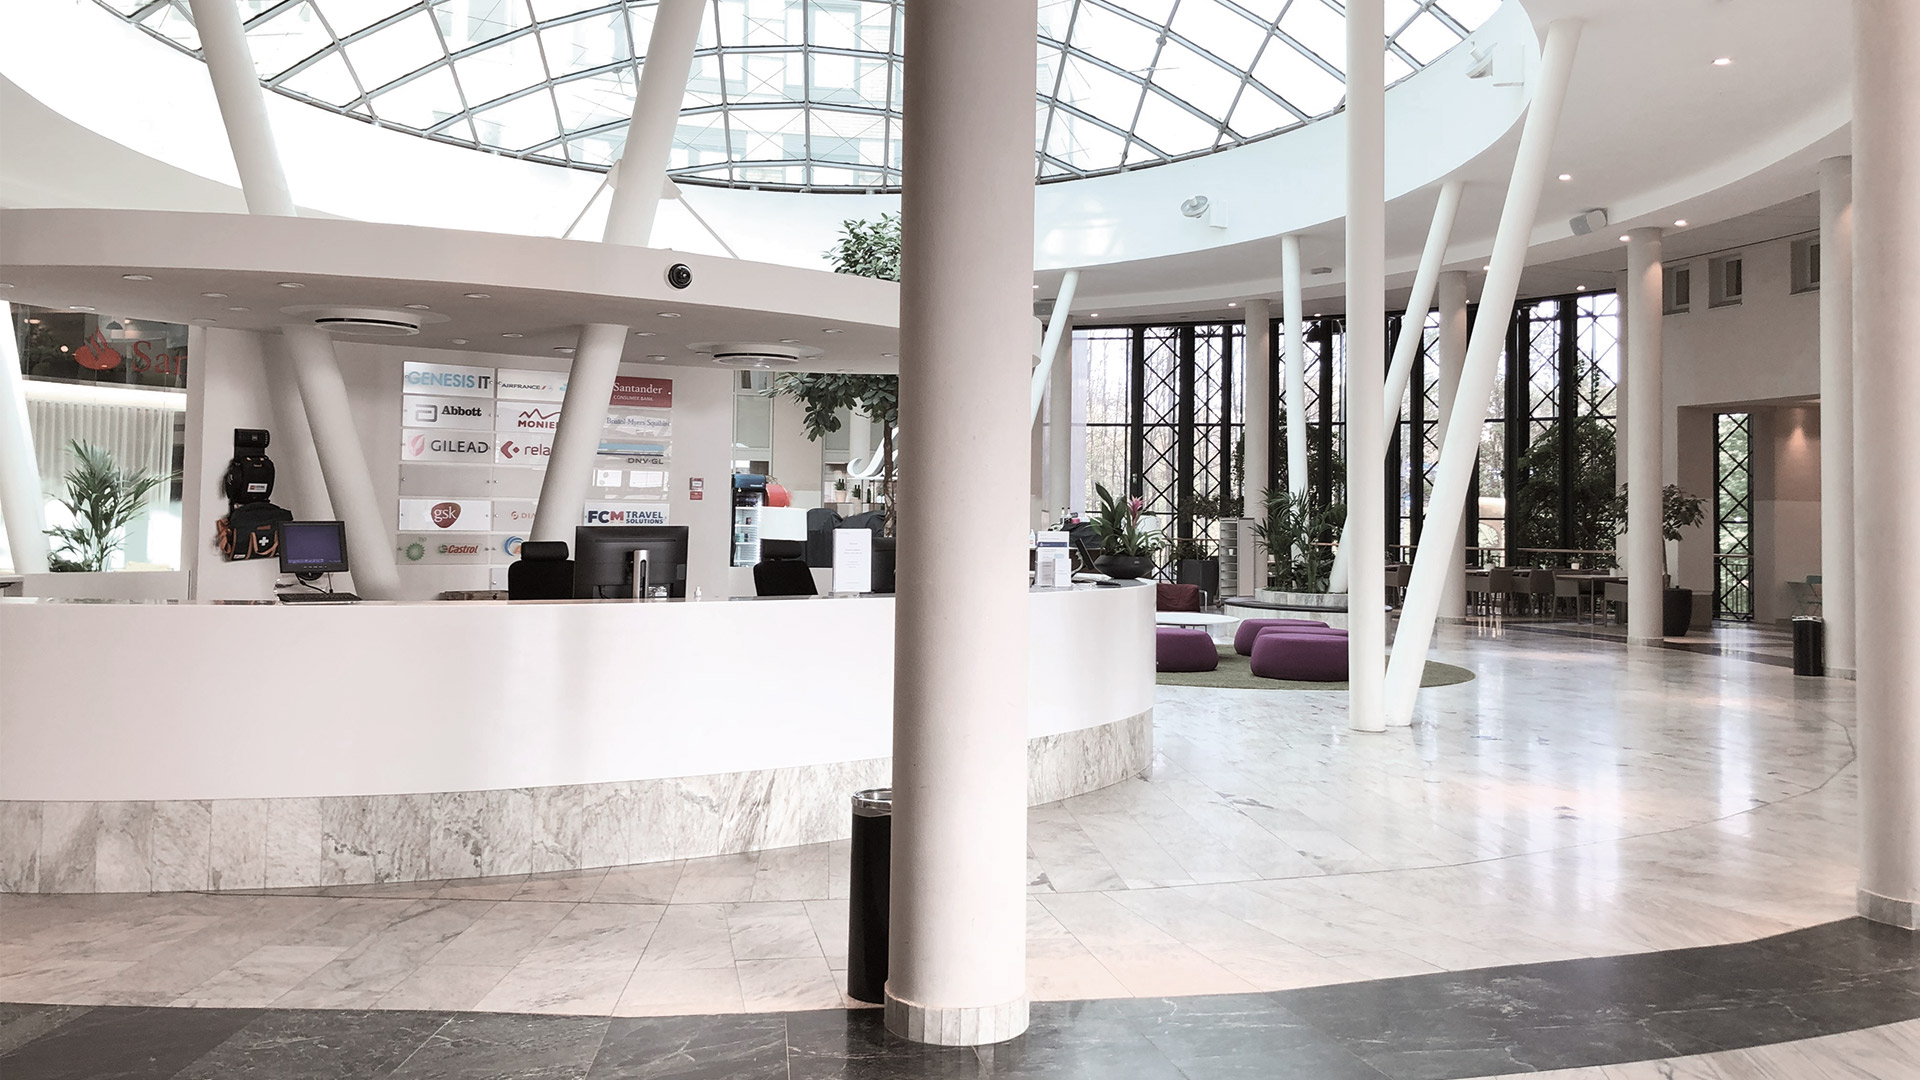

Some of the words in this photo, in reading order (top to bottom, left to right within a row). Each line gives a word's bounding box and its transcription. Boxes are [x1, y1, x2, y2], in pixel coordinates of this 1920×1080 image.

[407, 371, 475, 388] GENESIS
[478, 375, 490, 389] IT
[613, 382, 662, 394] Santander
[441, 405, 482, 417] Abbott
[431, 440, 489, 454] GILEAD
[524, 444, 551, 456] rela
[433, 507, 457, 523] gsk
[587, 510, 624, 523] FCM
[625, 511, 664, 519] TRAVEL
[447, 544, 479, 554] Castrol
